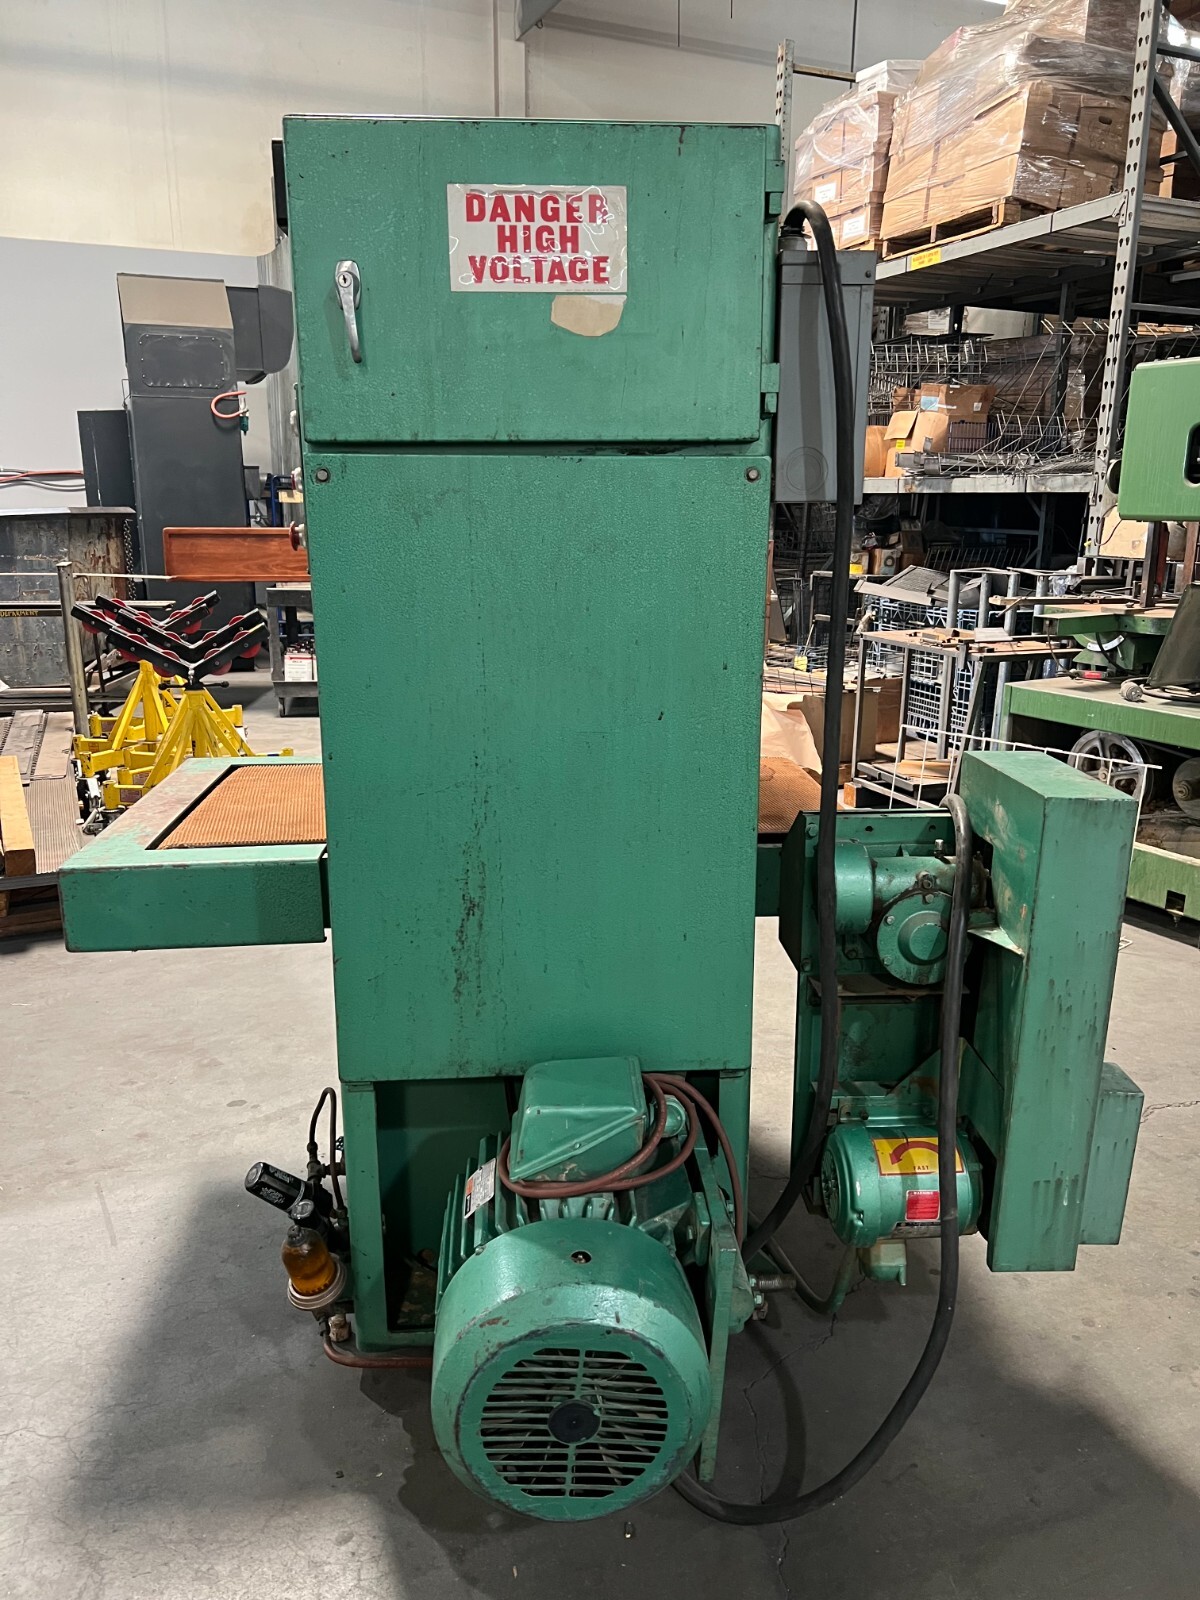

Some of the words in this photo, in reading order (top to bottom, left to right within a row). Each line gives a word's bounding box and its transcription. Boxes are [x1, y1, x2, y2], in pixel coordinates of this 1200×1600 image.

[465, 193, 608, 223] DANGER
[497, 225, 580, 253] HIGH
[468, 255, 610, 284] VOLTAGE
